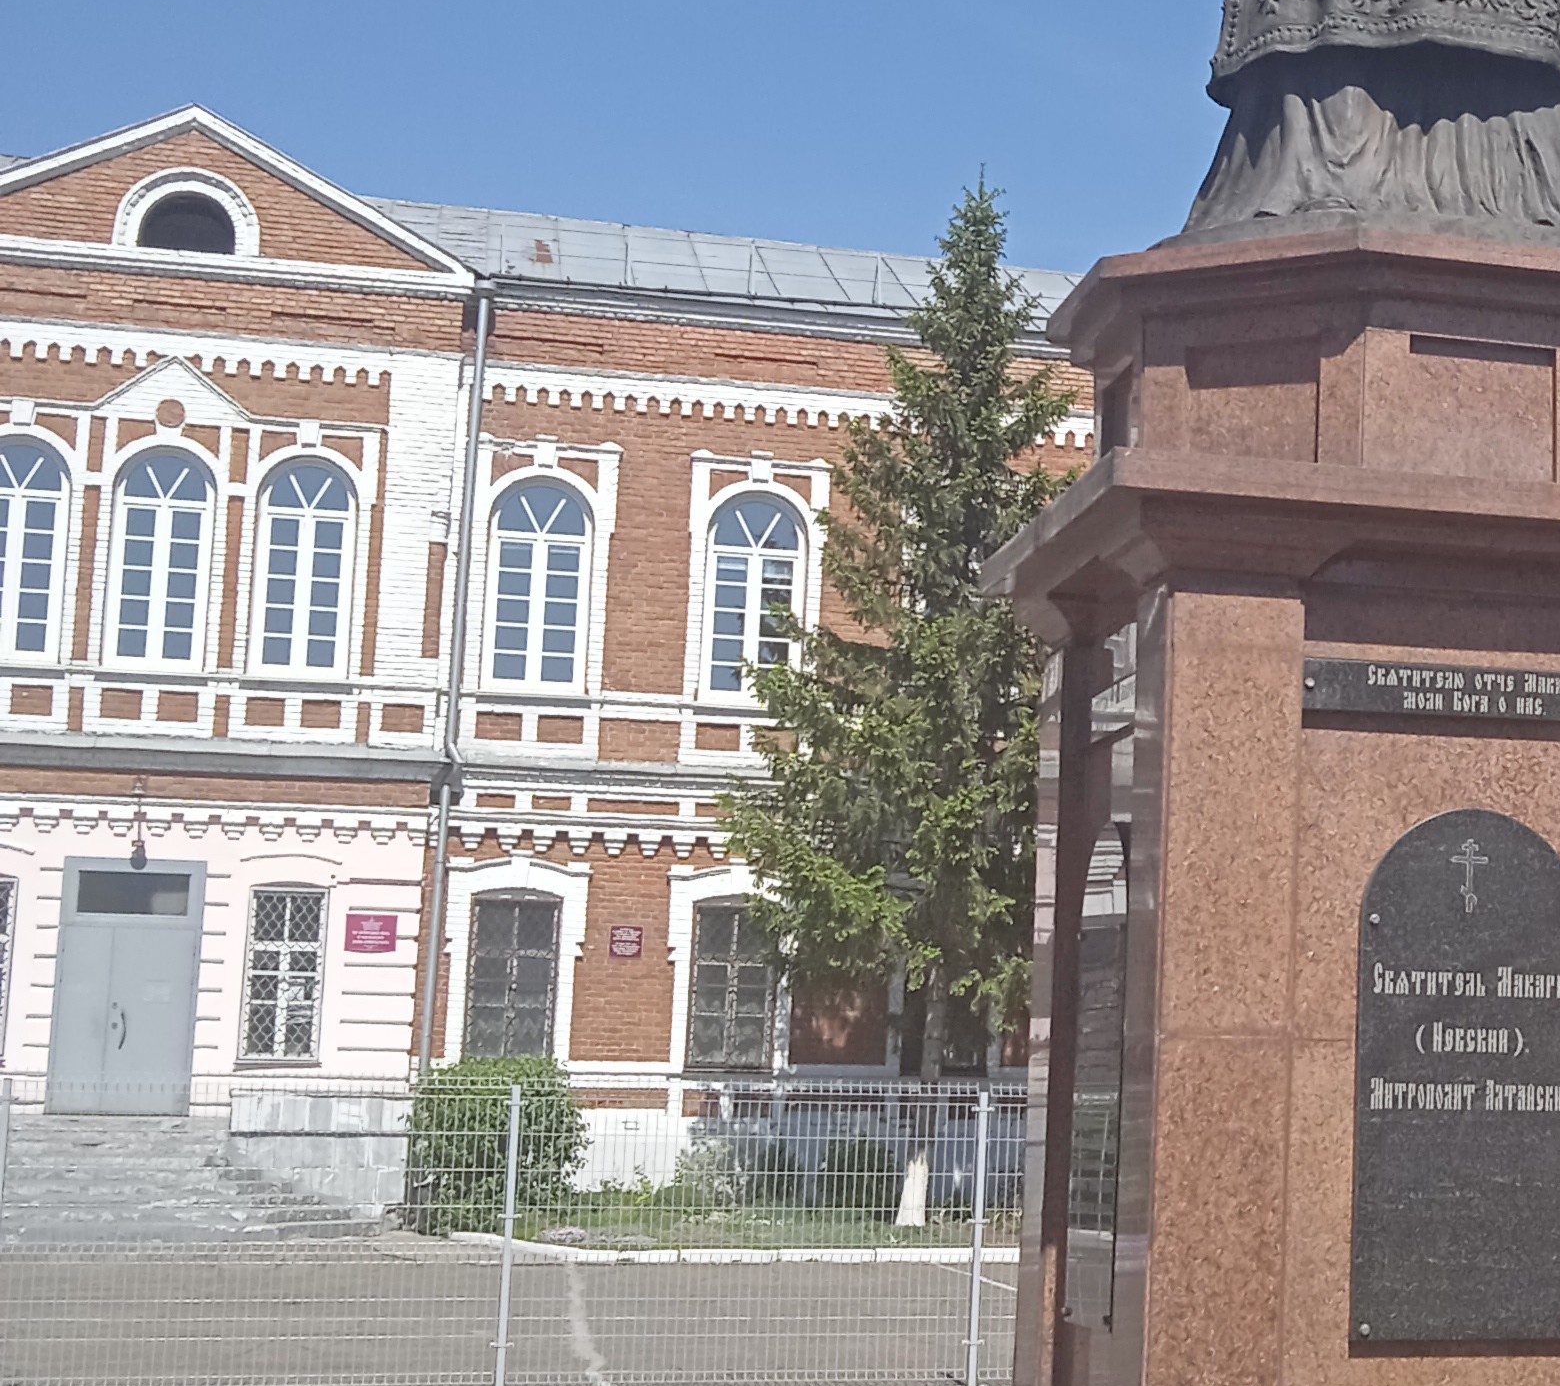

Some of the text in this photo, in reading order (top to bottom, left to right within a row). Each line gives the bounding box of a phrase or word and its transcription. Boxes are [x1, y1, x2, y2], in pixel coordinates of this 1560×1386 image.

[1474, 673, 1515, 692] отче
[1453, 690, 1489, 713] Бога
[1498, 696, 1507, 713] о
[1370, 1077, 1476, 1111] Митрополит
